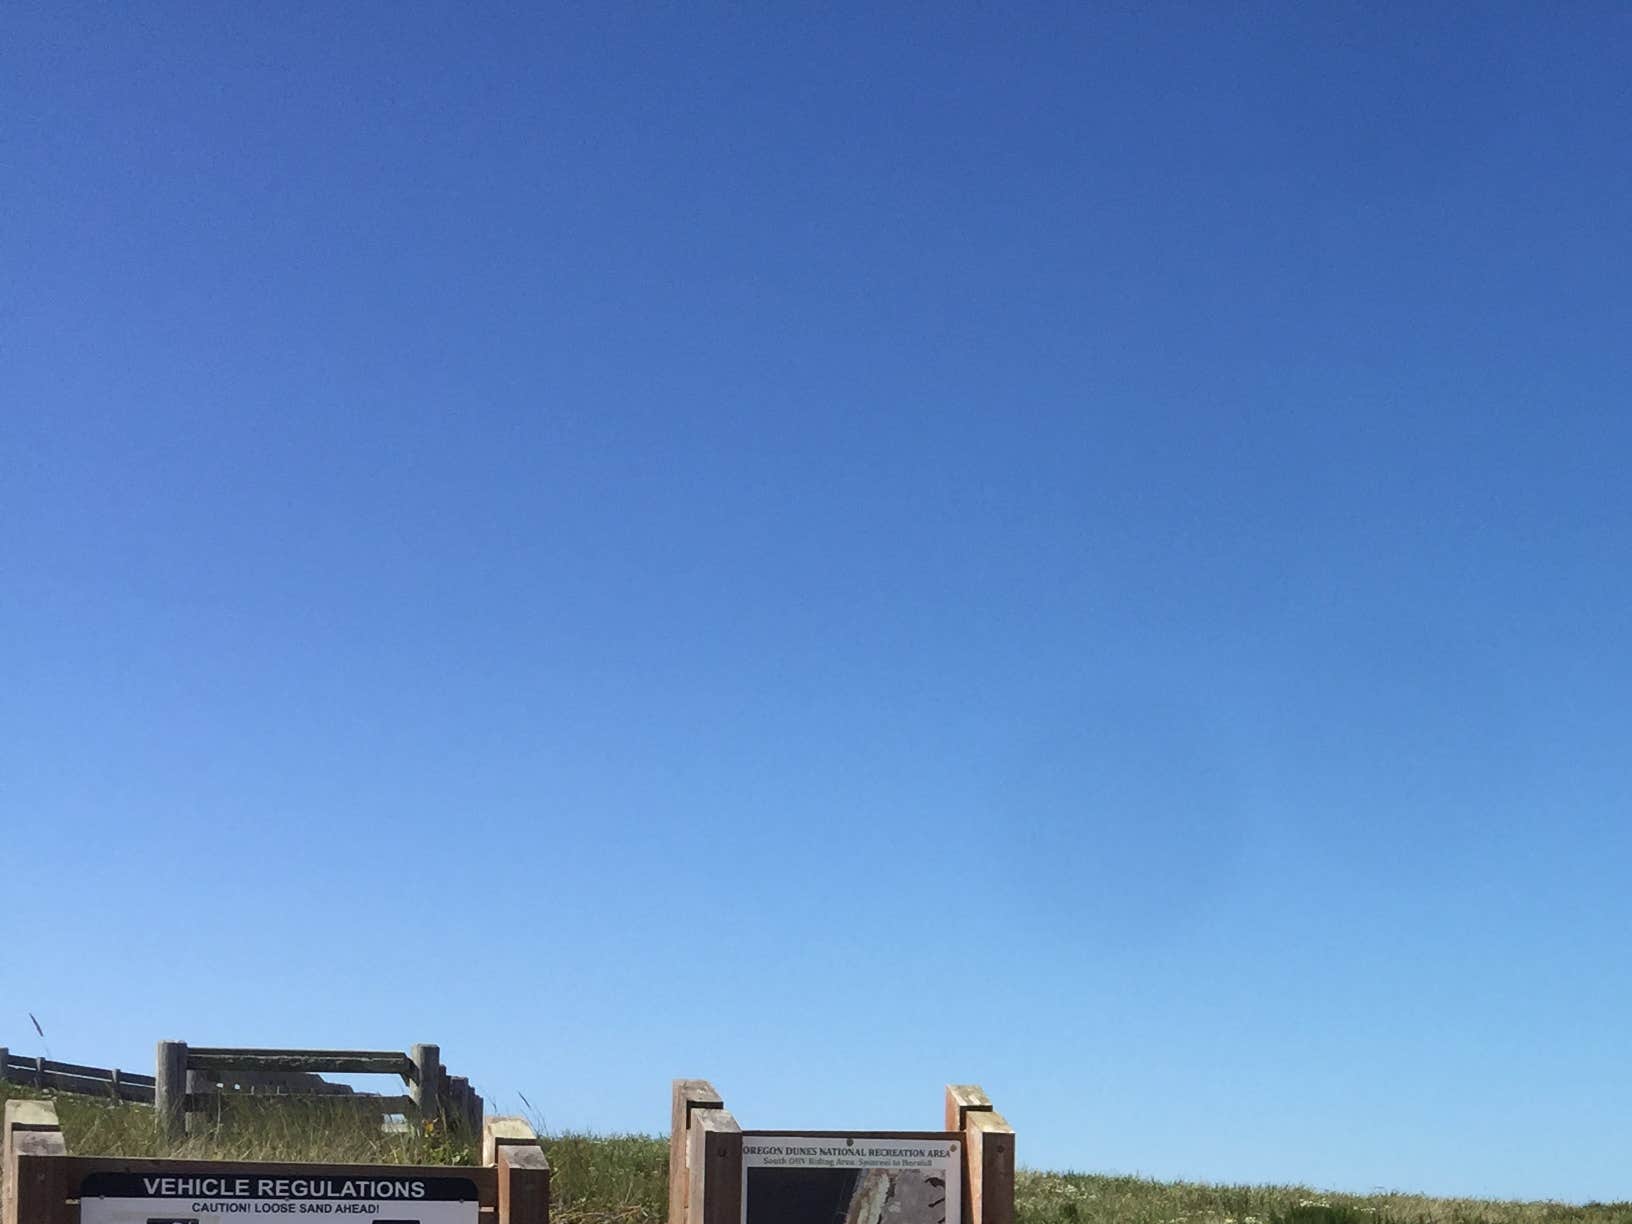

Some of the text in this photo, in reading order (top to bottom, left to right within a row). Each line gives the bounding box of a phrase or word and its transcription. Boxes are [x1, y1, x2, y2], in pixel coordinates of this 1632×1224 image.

[742, 1146, 951, 1158] OREGON DUNES NATIONAL RECREATION AREA
[143, 1178, 425, 1198] VEHICLE REGULATIONS
[192, 1202, 380, 1214] CAUTION! LOOSE SAND AHEAD!
